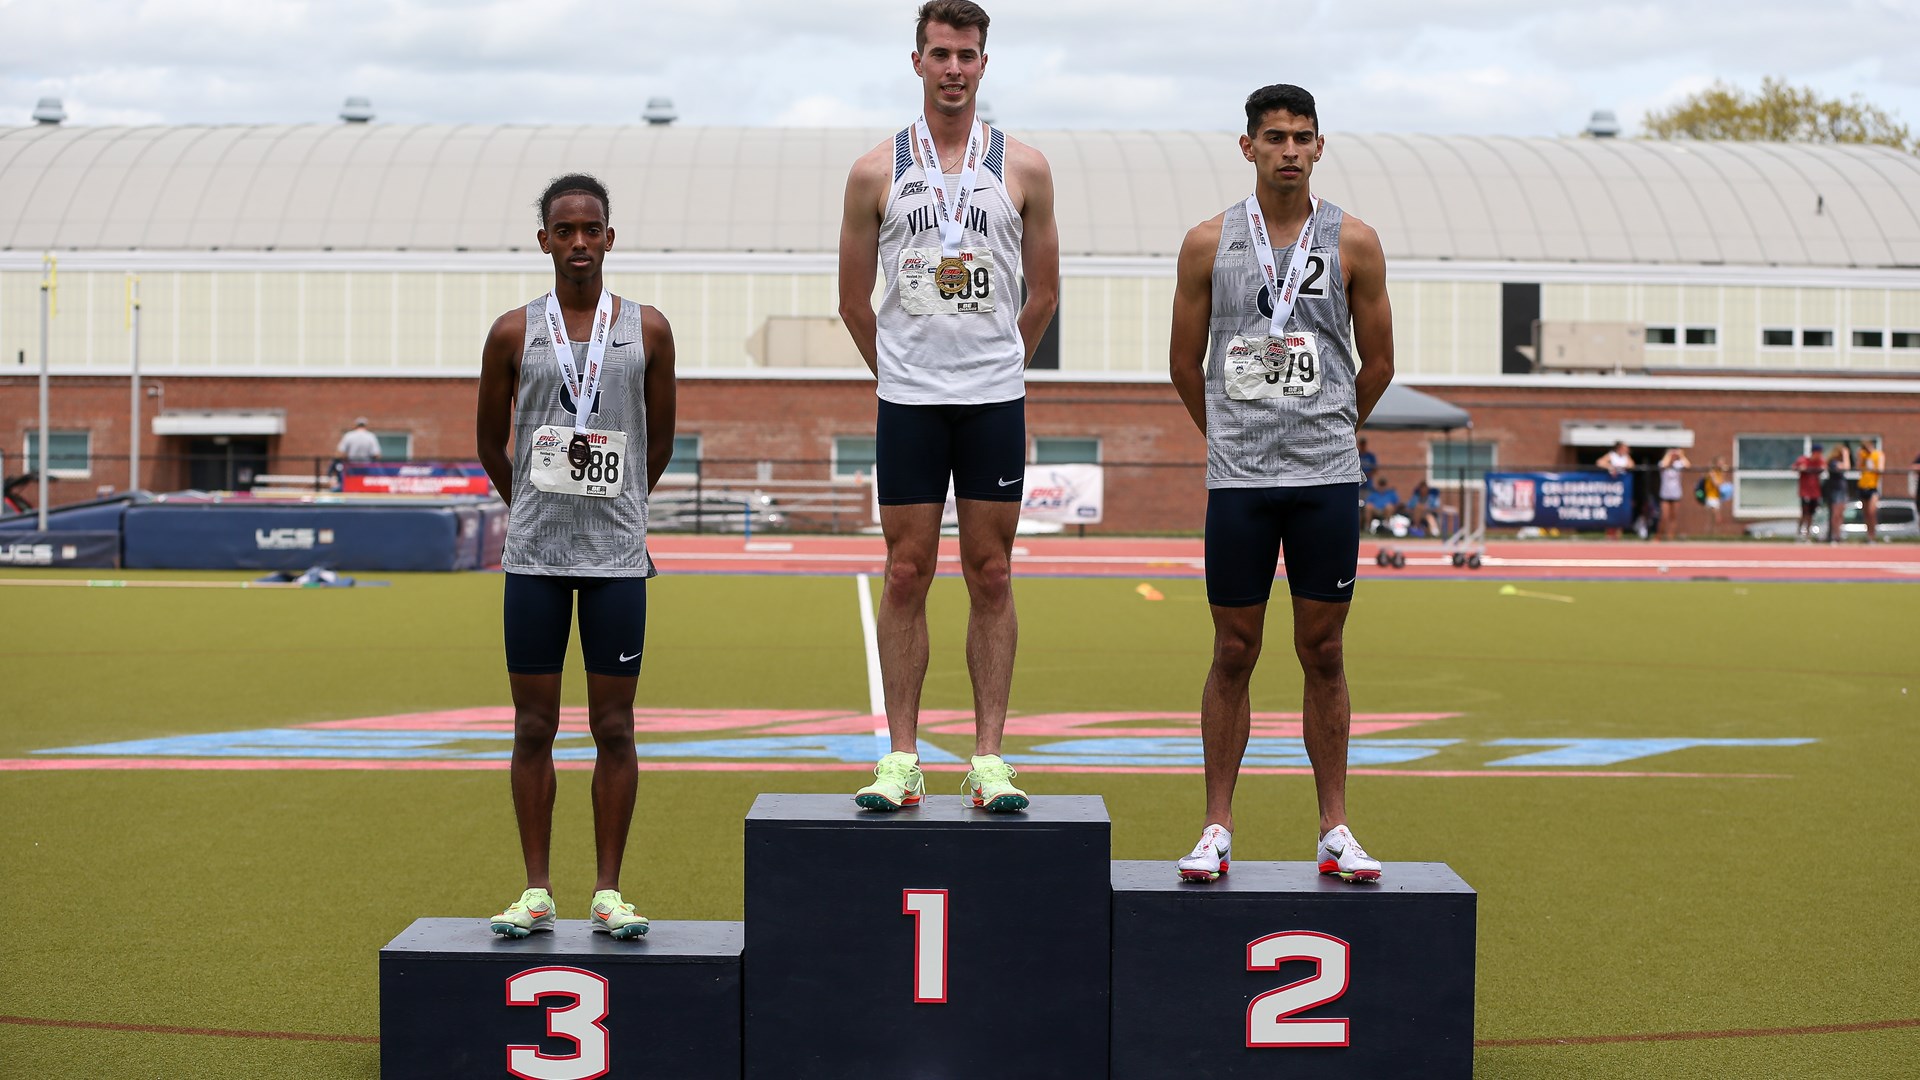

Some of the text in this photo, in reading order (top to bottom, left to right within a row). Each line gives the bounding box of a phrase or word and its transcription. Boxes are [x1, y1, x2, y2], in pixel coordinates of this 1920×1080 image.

[900, 187, 929, 196] EAST
[904, 181, 924, 190] BIG
[907, 205, 988, 238] VILLVA
[1256, 227, 1267, 247] EAST
[1288, 266, 1298, 289] EAST
[1298, 255, 1325, 296] 2
[1029, 487, 1065, 500] BIG
[1541, 481, 1624, 496] CELEBRATING
[1603, 494, 1623, 508] OF
[255, 528, 315, 544] UCS
[902, 889, 950, 1003] 1
[1245, 930, 1351, 1048] 2
[505, 966, 610, 1080] 3
